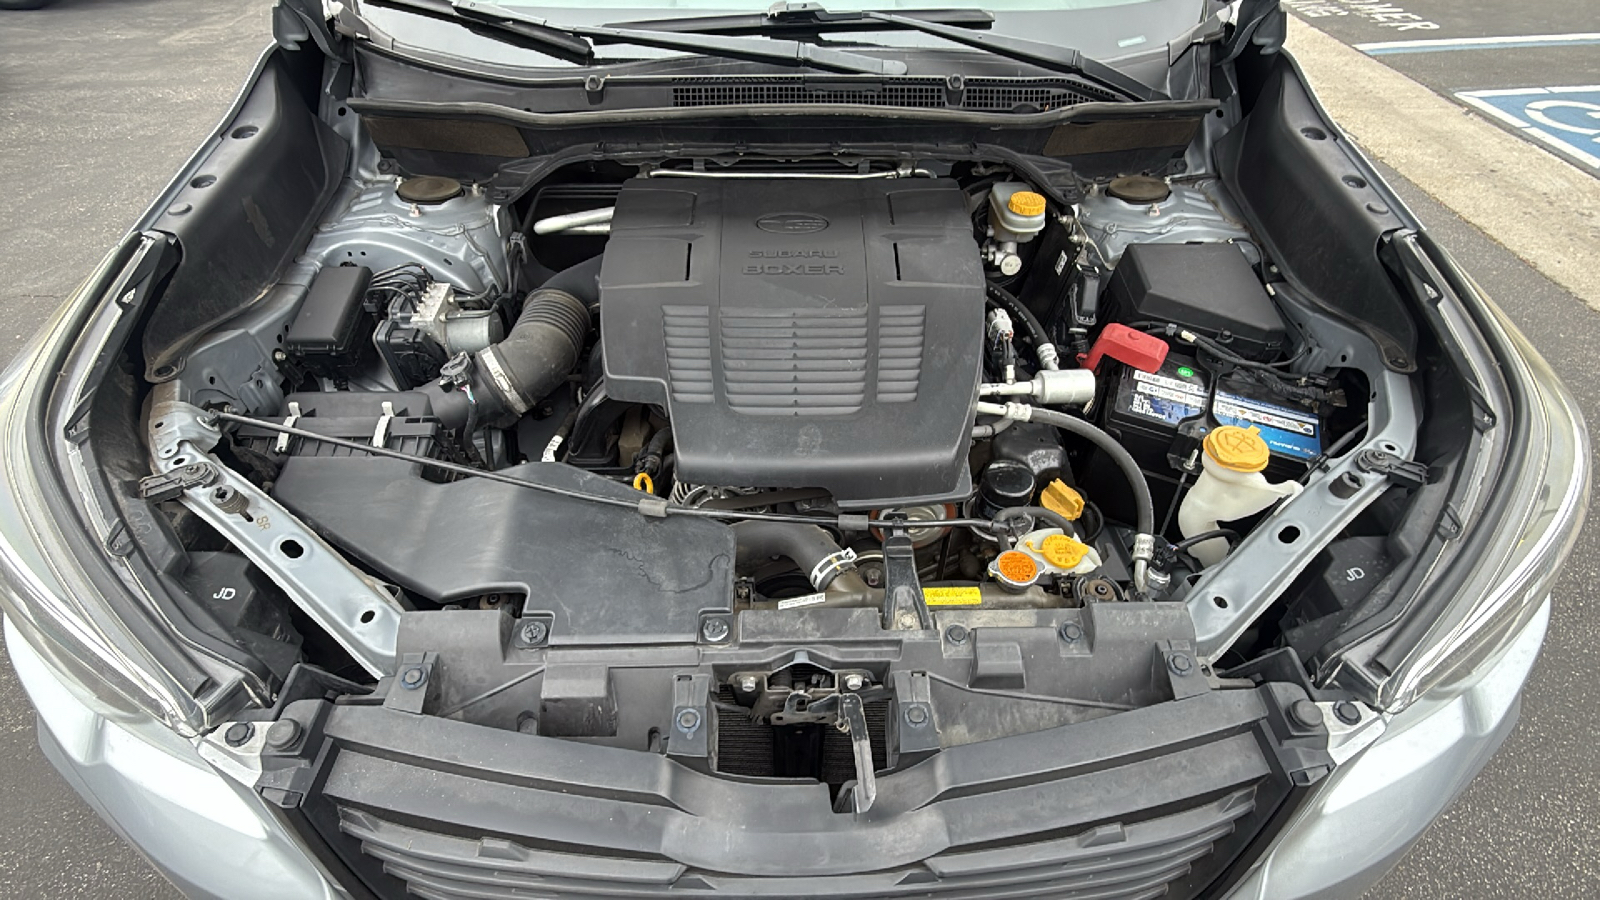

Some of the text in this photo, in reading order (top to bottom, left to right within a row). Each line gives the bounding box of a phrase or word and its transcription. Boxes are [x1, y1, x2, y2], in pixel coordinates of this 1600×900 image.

[749, 250, 838, 259] SUBARU
[742, 264, 845, 275] BOXER
[212, 587, 236, 600] JD
